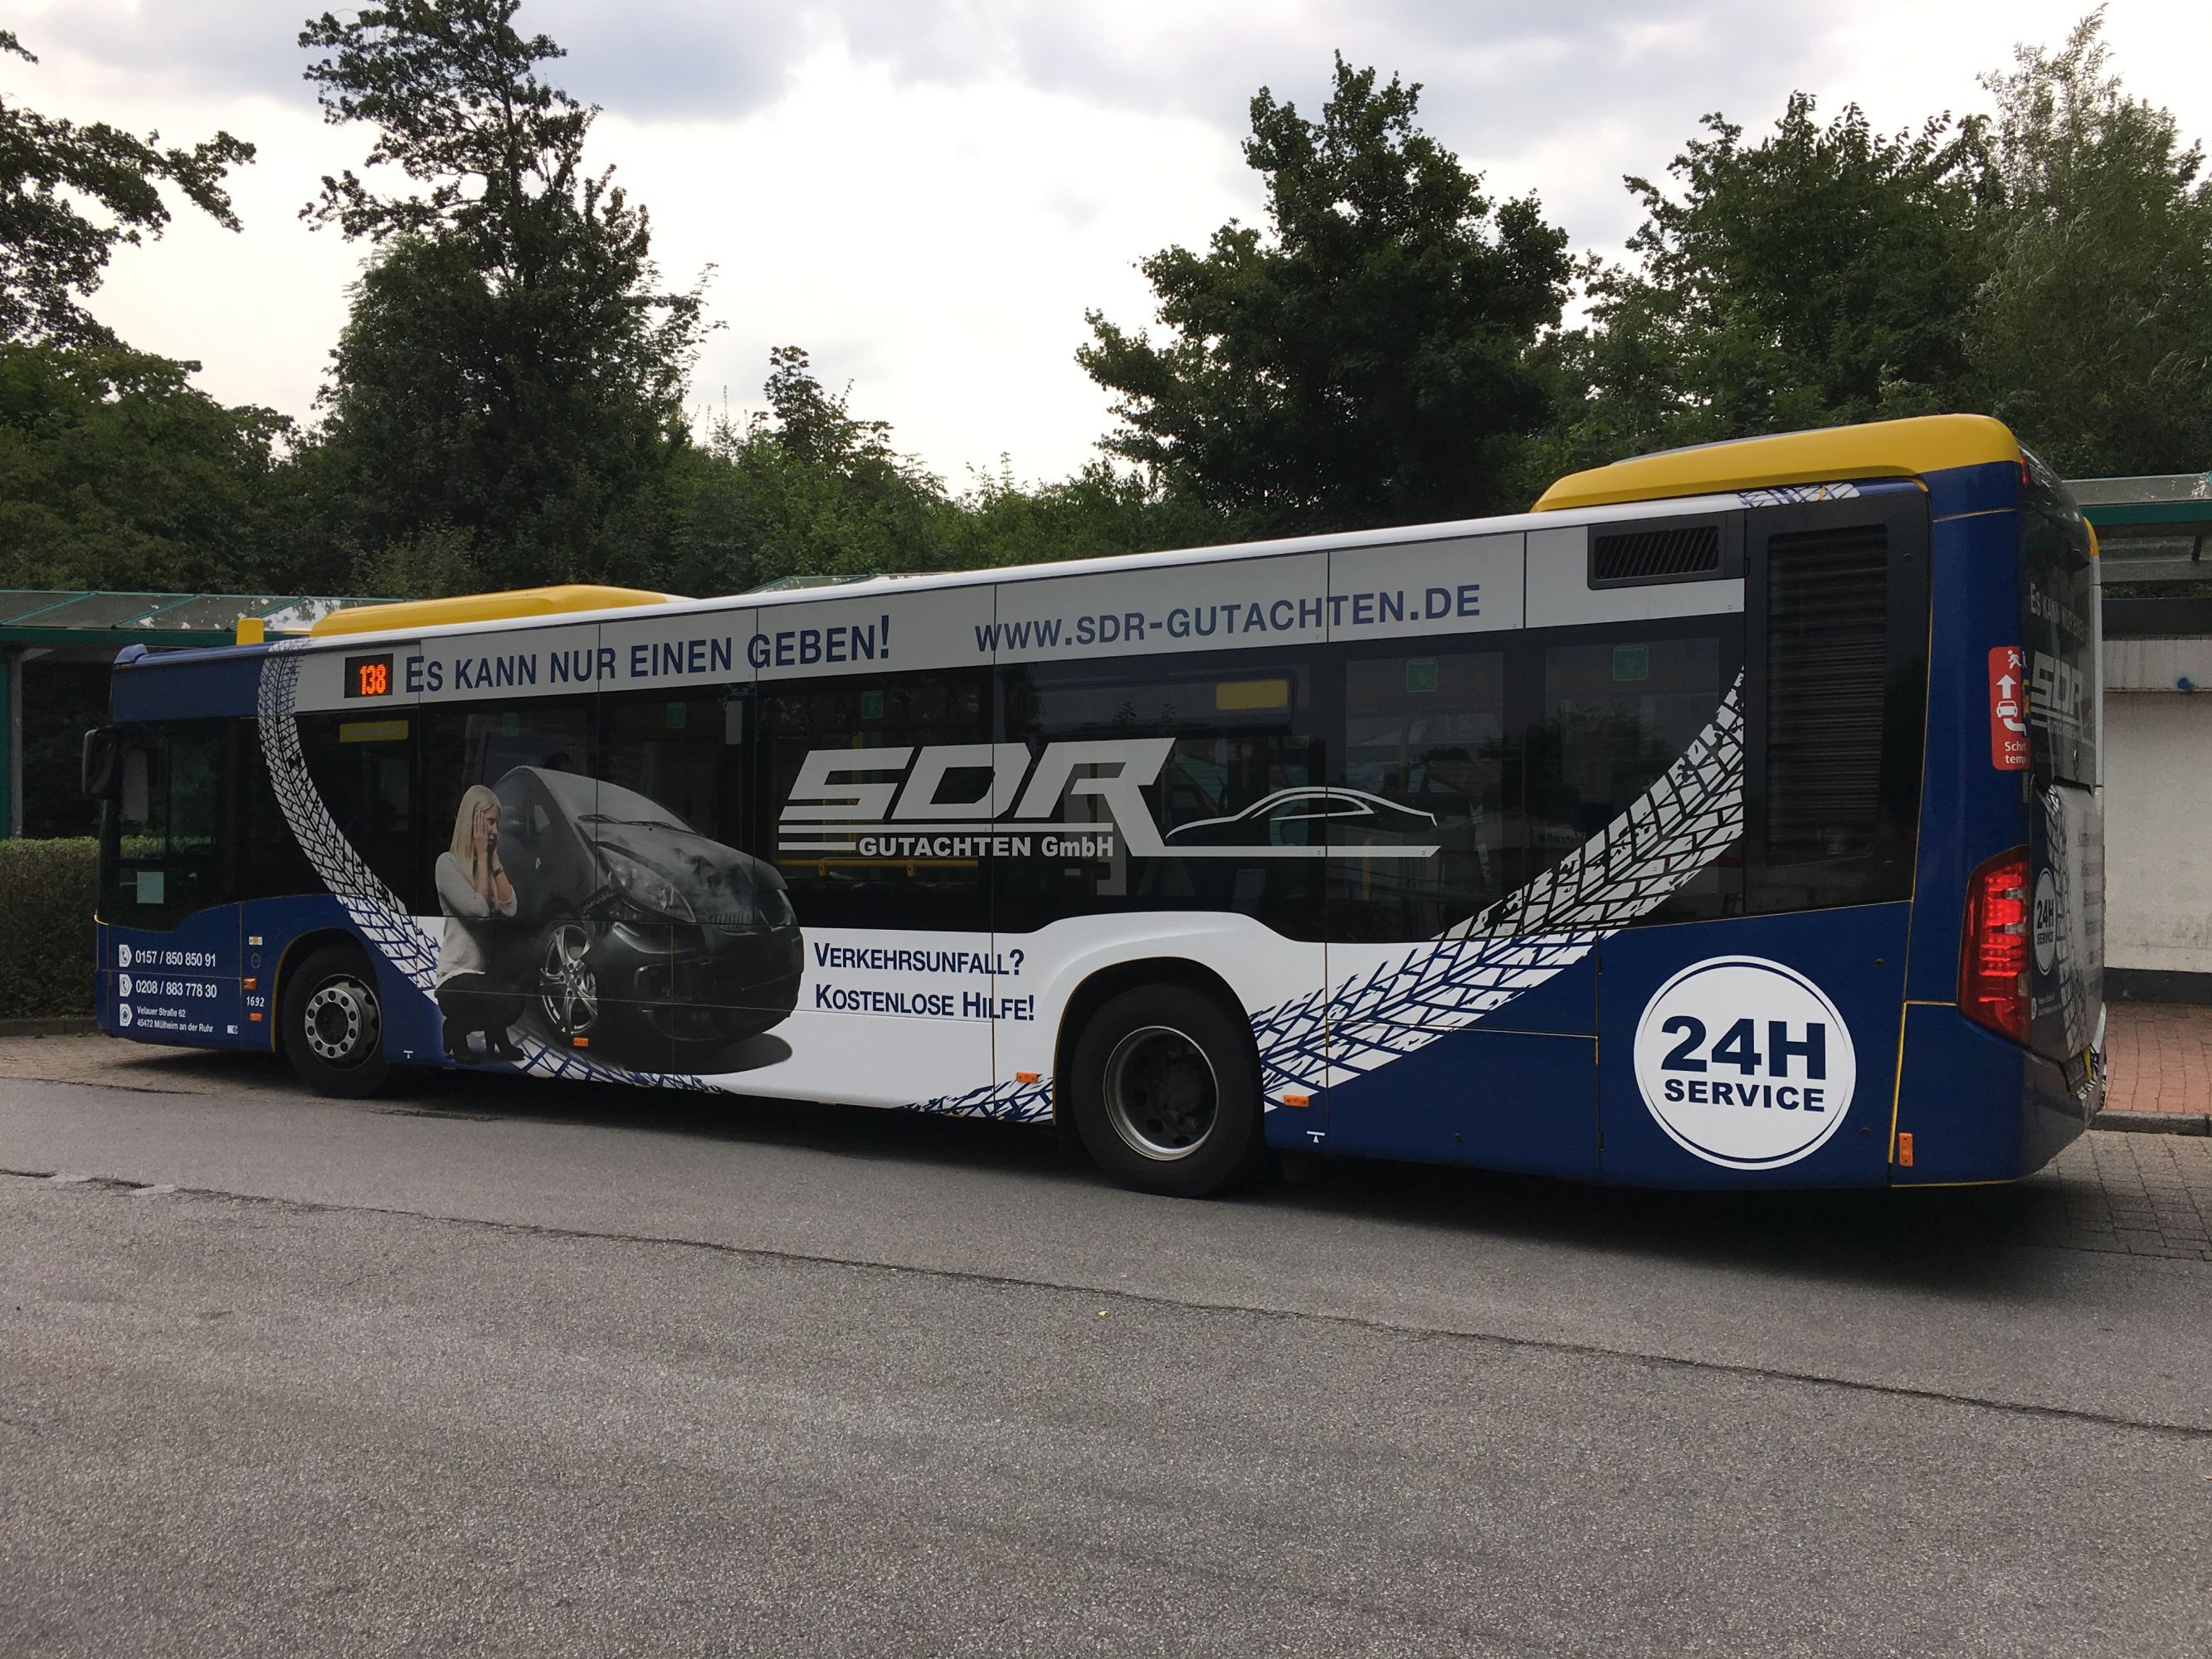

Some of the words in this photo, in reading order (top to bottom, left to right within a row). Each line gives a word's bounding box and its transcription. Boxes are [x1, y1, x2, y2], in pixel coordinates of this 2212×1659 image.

[974, 583, 1481, 652] WWW.SDR-GUTACHTEN.DE
[406, 655, 443, 693] ES
[455, 654, 537, 689] KANN
[550, 648, 616, 684] NUR
[631, 637, 732, 677] EINEN
[747, 615, 889, 669] GEBEN!
[358, 663, 387, 695] 138
[778, 737, 1177, 857] SDR
[858, 836, 1031, 858] GUTACHTEN
[1041, 835, 1114, 858] GmbH
[2036, 898, 2054, 929] 24H
[135, 950, 158, 964] 0157
[165, 951, 183, 966] 850
[185, 952, 202, 967] 850
[204, 953, 216, 967] 91
[814, 942, 1025, 975] VERKEHRSUNFALL?
[135, 980, 158, 995] 0208
[166, 981, 183, 996] 883
[185, 982, 203, 997] 778
[204, 984, 217, 998] 30
[246, 995, 265, 1008] 1692
[816, 984, 954, 1016] KOSTENLOSE
[962, 991, 1035, 1021] HILFE!
[153, 1019, 178, 1030] Mülheim
[179, 1023, 187, 1031] an
[188, 1022, 198, 1032] der
[198, 1023, 213, 1033] Ruhr
[158, 1007, 178, 1018] Straße
[178, 1009, 186, 1018] 62
[1661, 1014, 1826, 1081] 24H
[1664, 1078, 1825, 1113] SERVICE
